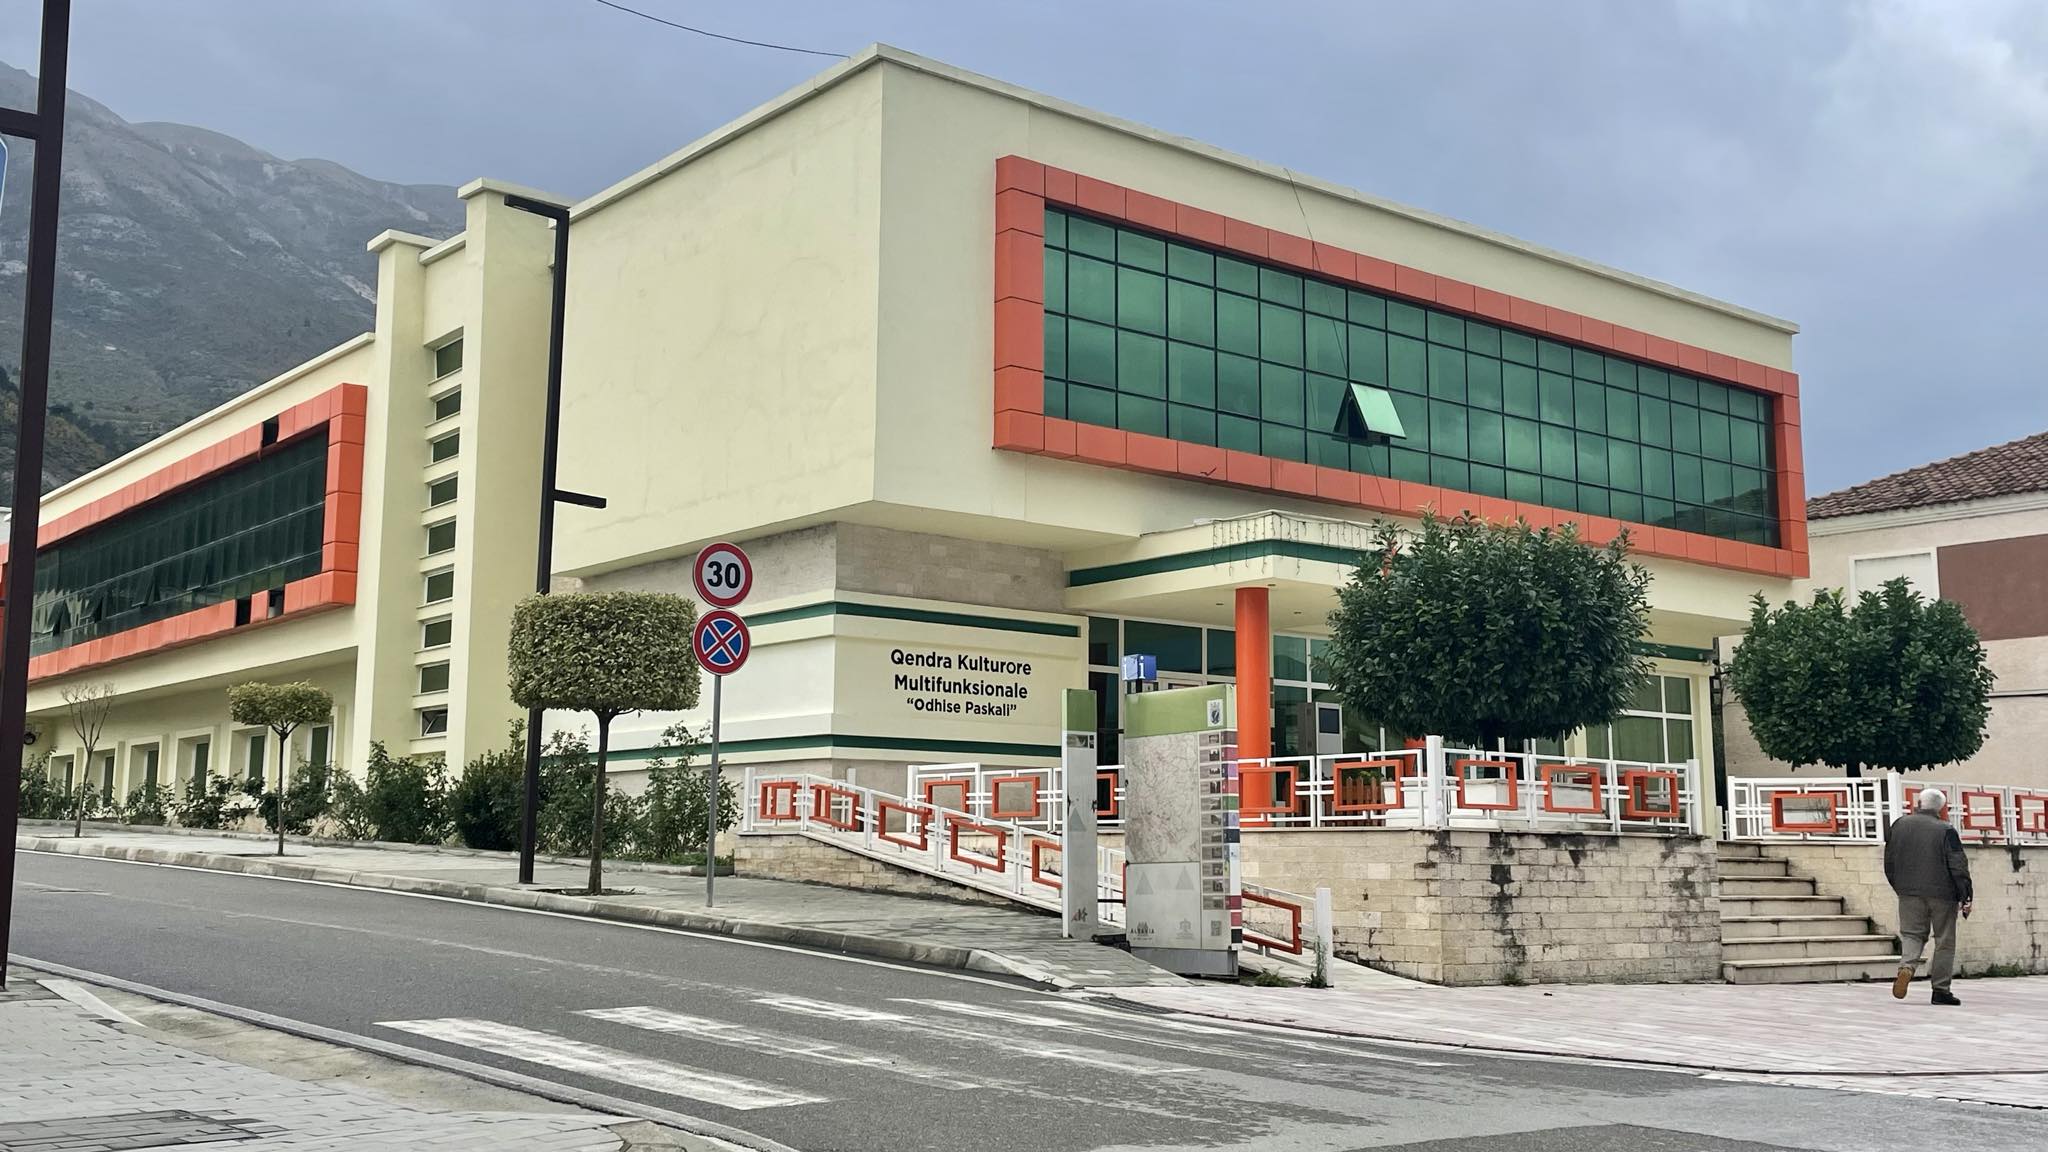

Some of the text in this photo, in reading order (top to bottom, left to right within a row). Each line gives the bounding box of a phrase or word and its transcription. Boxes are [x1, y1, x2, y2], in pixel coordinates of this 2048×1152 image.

[707, 561, 741, 589] 30
[891, 649, 1032, 675] Qendra Kulturore
[894, 674, 1028, 699] Multifunksionale
